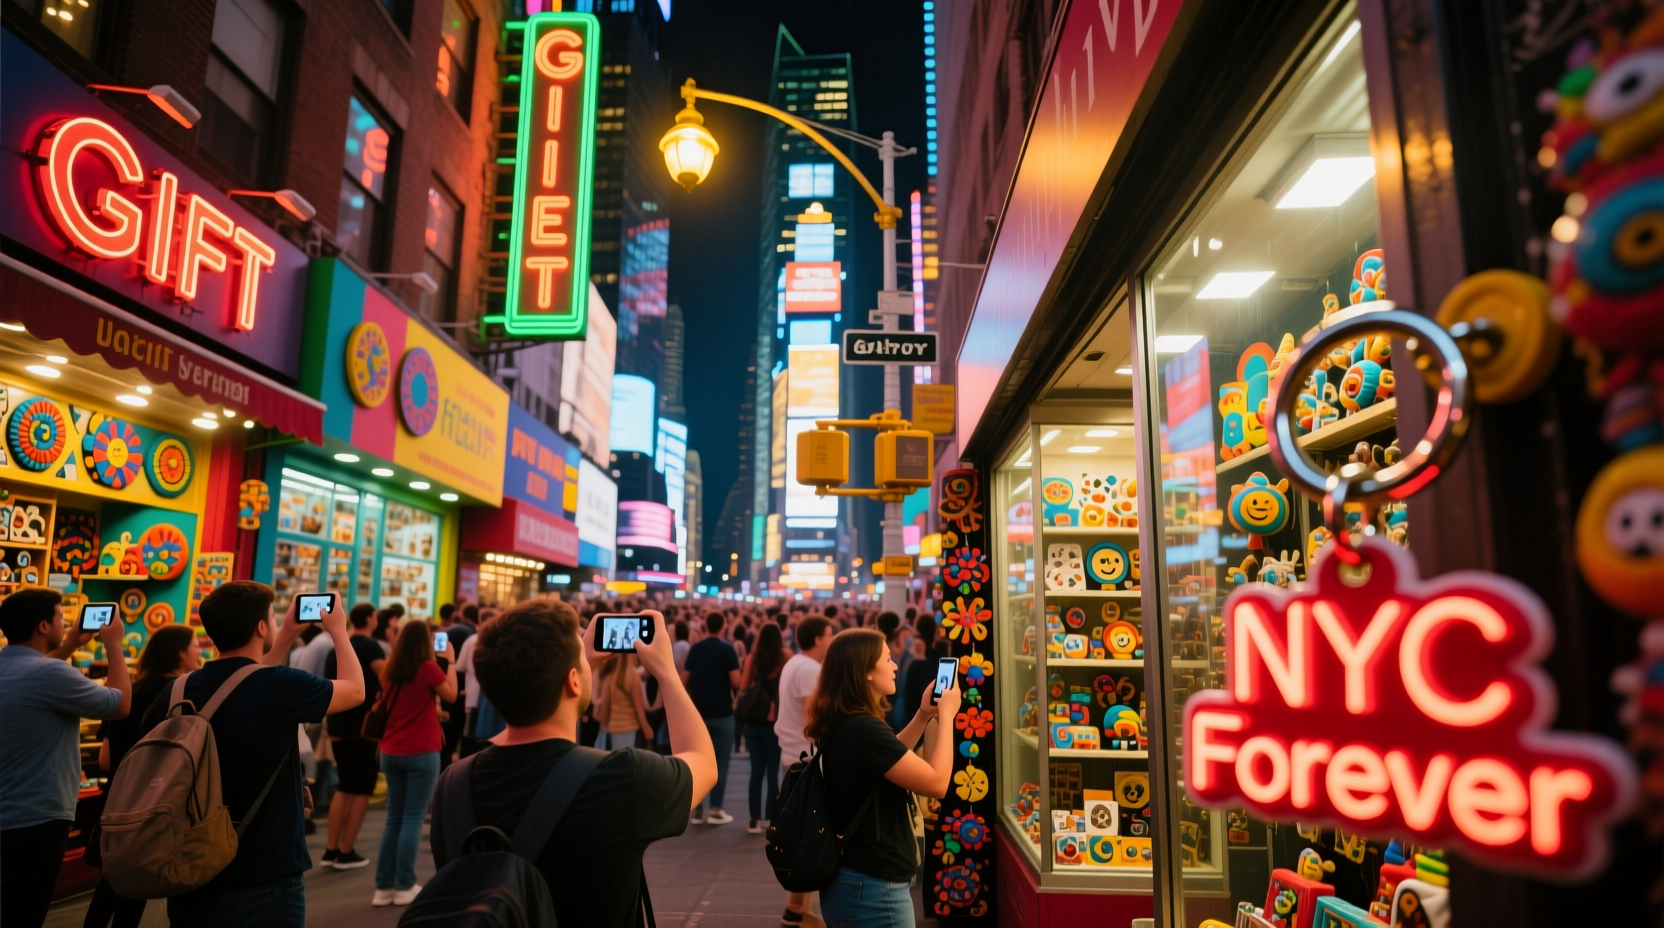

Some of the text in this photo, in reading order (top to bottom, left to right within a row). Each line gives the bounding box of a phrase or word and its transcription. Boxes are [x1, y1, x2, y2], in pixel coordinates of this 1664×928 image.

[39, 117, 276, 330] GIFT
[1233, 596, 1511, 727] NYC
[1191, 710, 1593, 856] Forever
